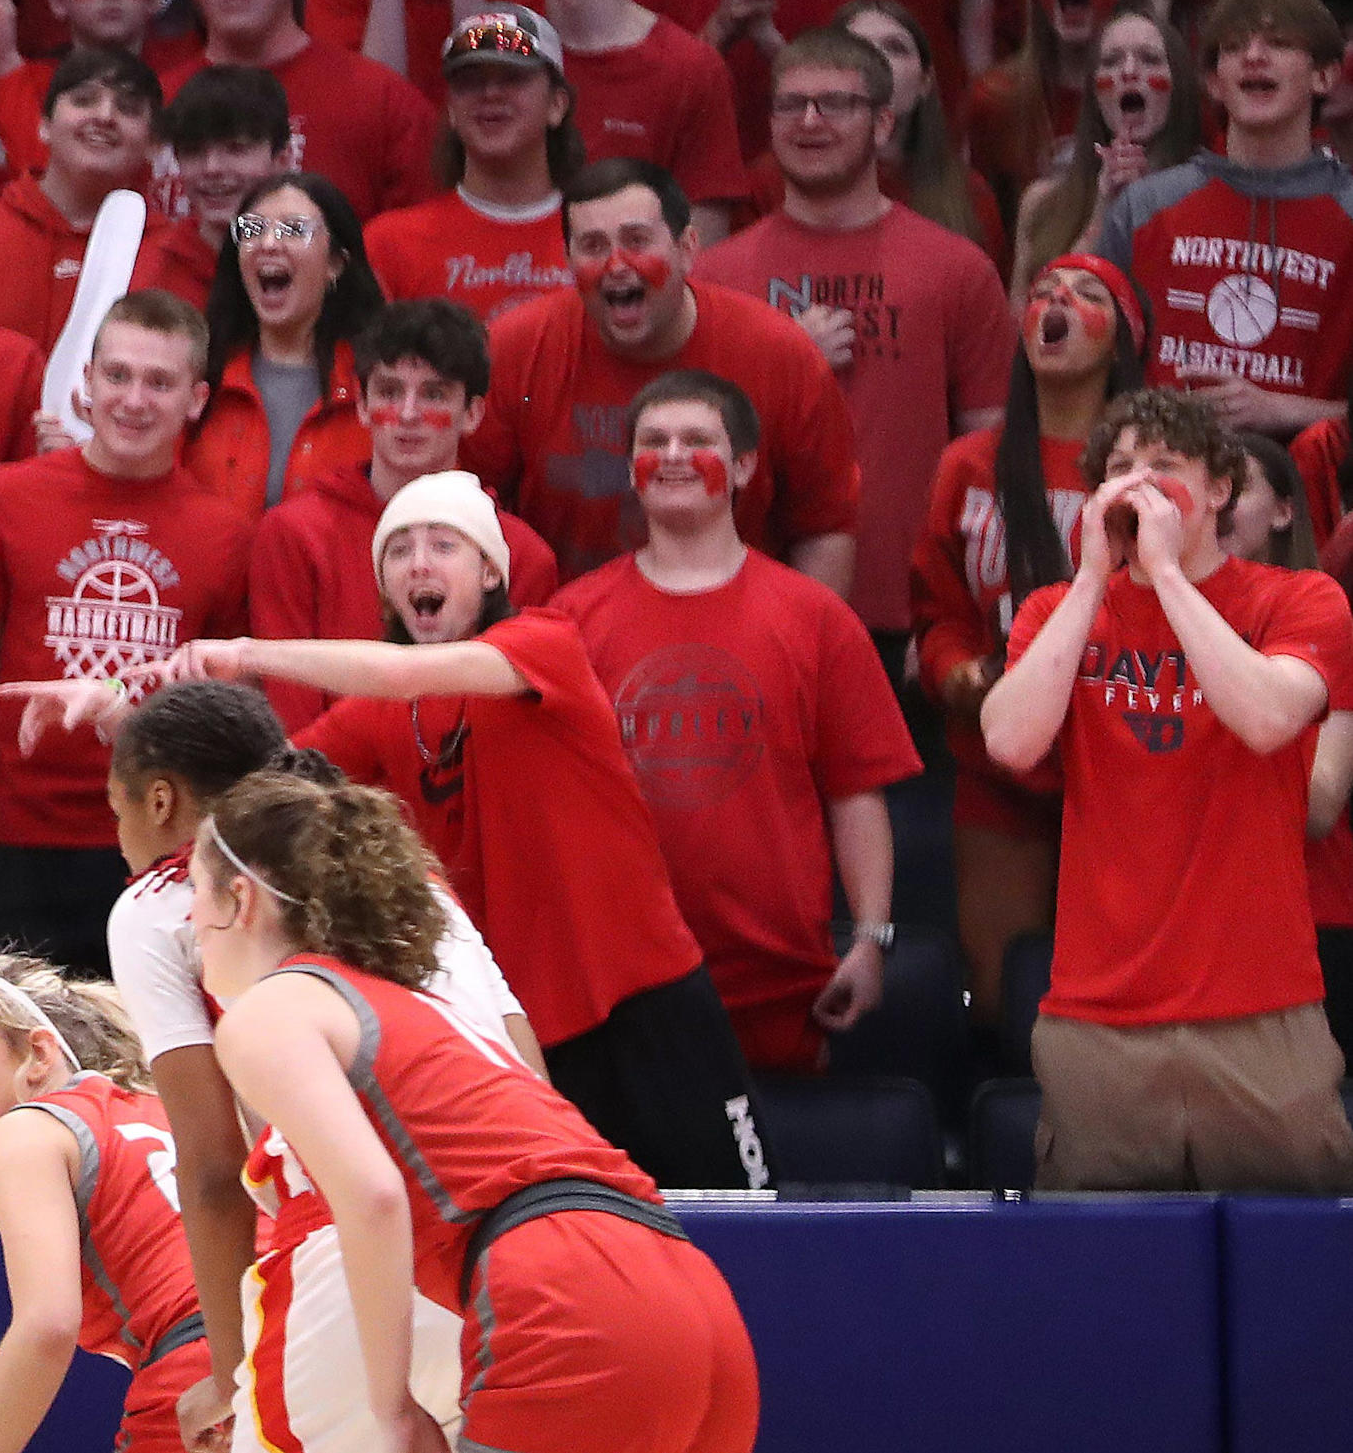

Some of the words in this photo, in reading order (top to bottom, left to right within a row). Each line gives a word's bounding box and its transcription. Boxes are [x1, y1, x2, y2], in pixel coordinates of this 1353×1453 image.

[1170, 235, 1336, 291] NORTHWEST
[1159, 334, 1305, 389] BASKETBALL
[1077, 642, 1185, 694] DAYT
